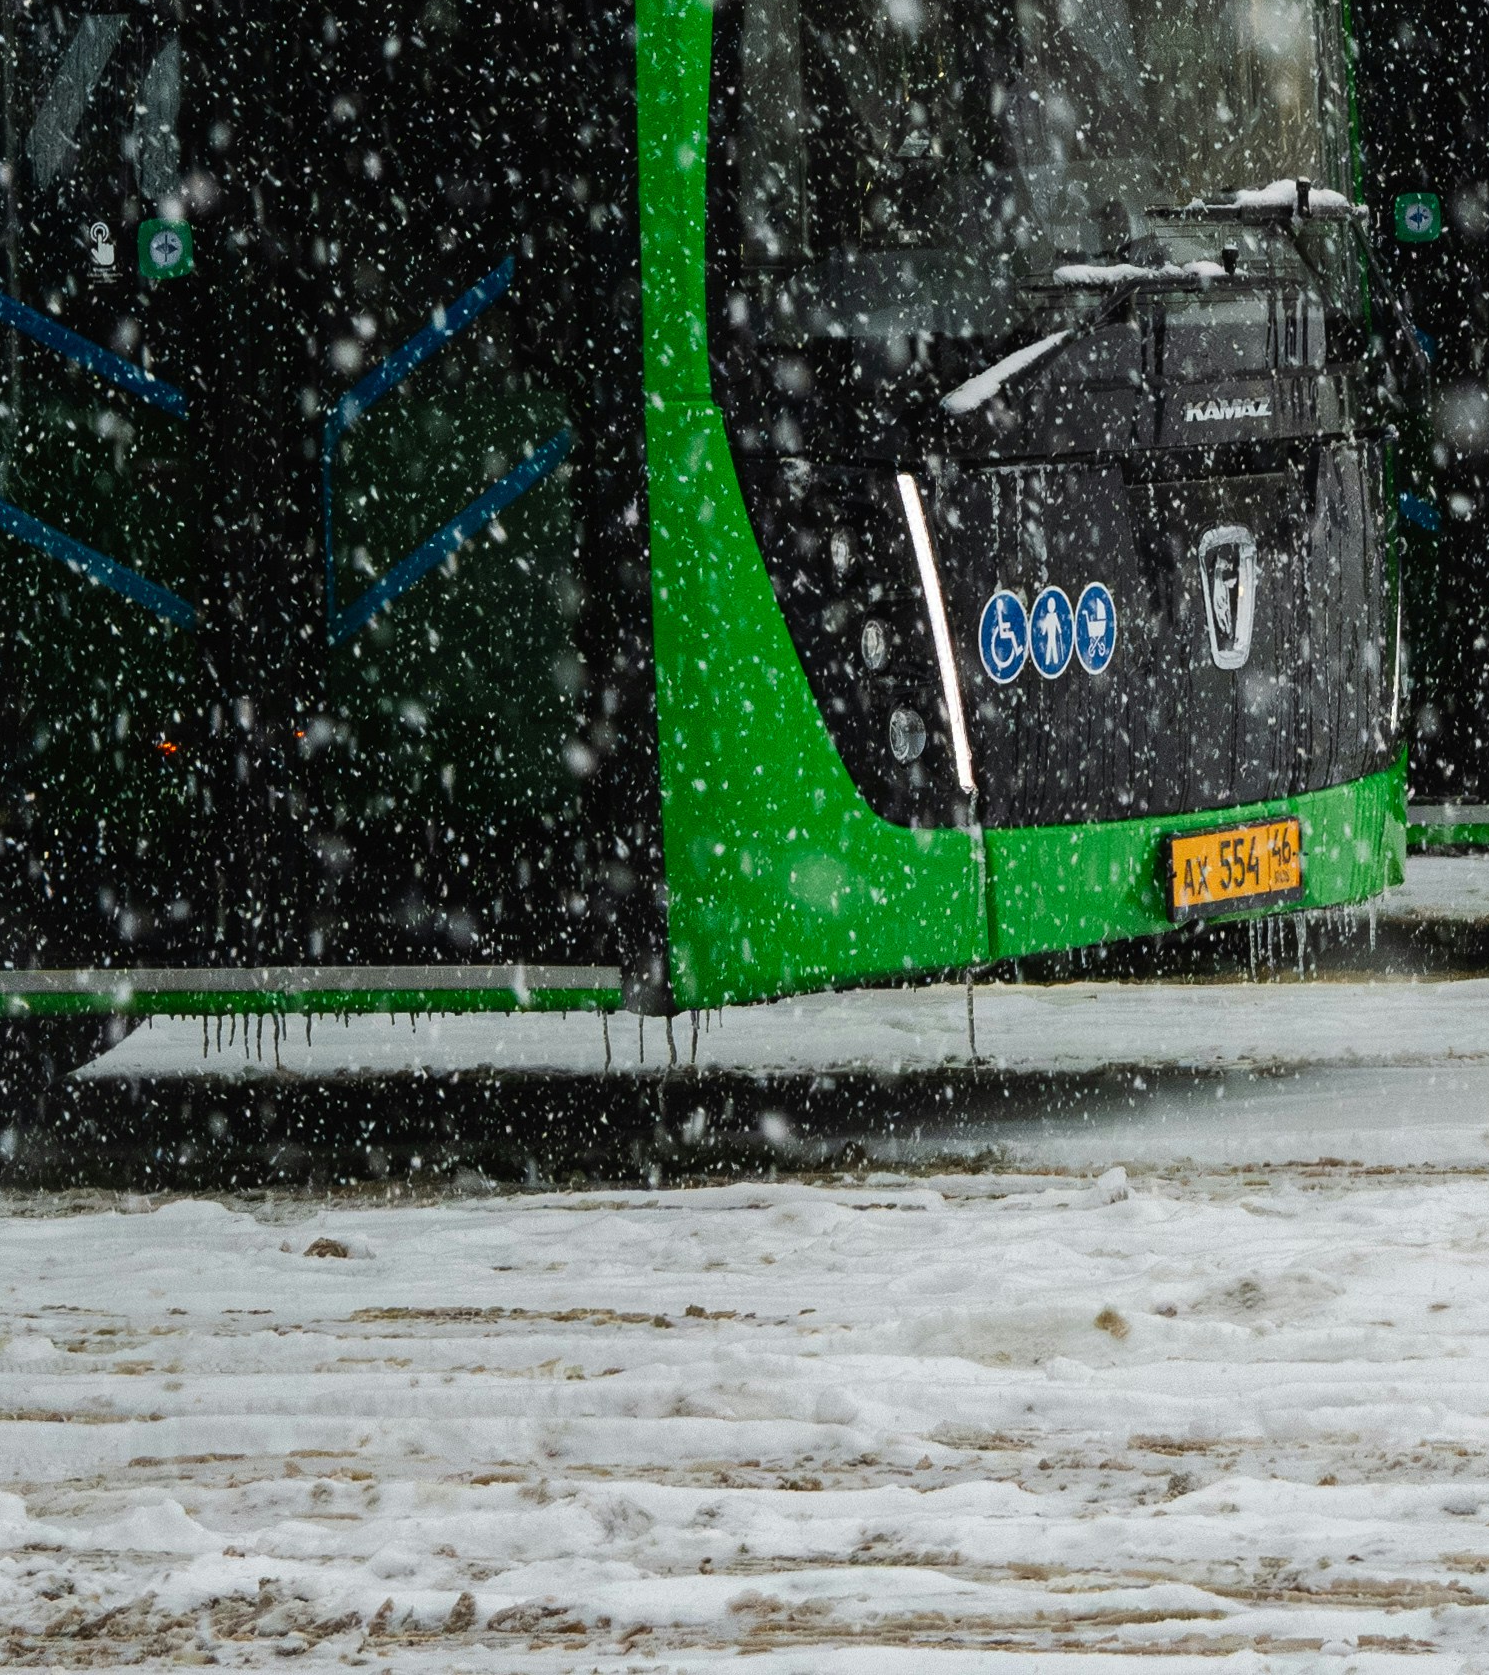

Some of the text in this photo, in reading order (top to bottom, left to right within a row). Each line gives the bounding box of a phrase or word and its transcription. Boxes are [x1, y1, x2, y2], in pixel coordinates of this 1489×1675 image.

[1183, 397, 1272, 422] KAMAZ
[1219, 835, 1260, 891] 554
[1271, 827, 1292, 867] 46
